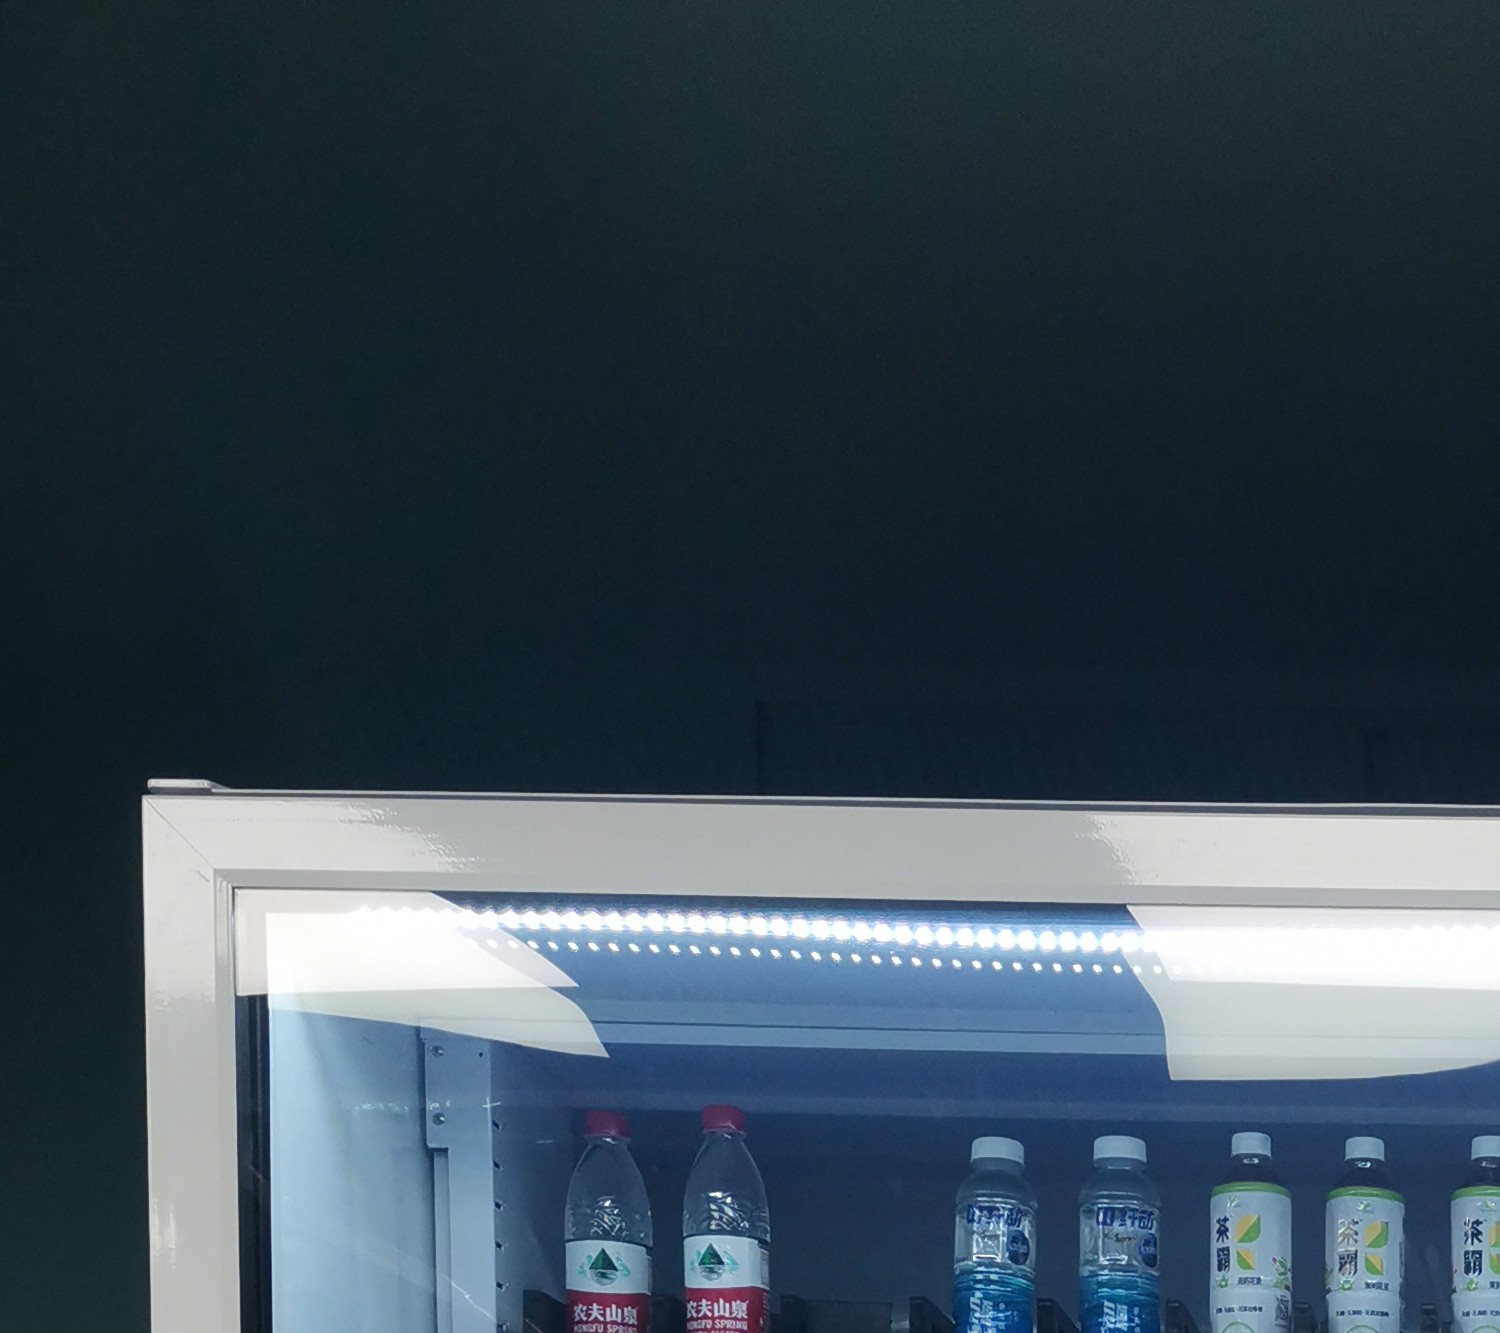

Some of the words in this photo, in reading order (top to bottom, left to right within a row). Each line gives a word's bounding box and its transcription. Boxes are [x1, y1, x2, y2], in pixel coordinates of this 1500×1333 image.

[573, 1302, 639, 1326] 农夫山泉
[685, 1297, 749, 1320] 农夫山泉
